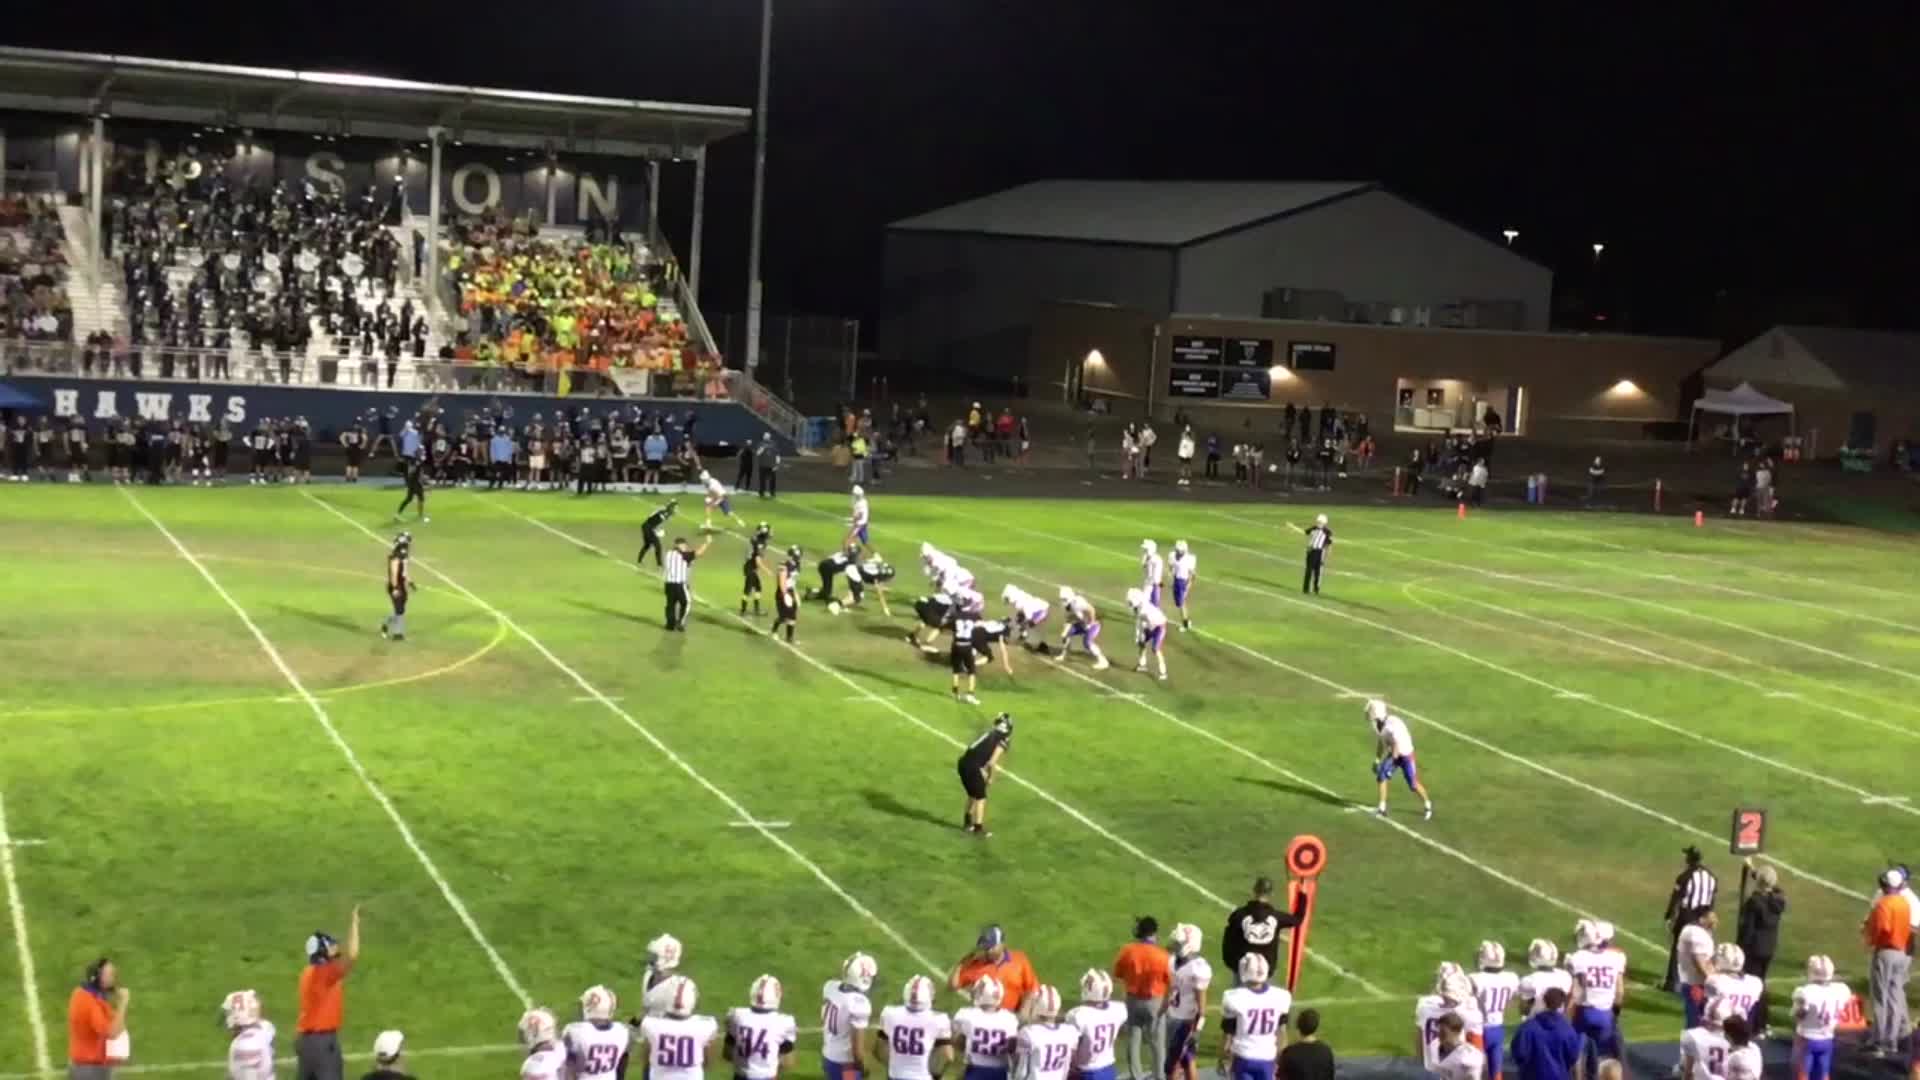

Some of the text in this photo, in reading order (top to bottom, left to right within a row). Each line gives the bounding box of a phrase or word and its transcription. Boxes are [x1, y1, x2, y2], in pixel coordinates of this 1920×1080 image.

[54, 389, 246, 423] HAWKS
[1738, 811, 1761, 848] 2
[1487, 987, 1511, 1012] 10
[1247, 1008, 1275, 1035] 76
[657, 1034, 695, 1068] 50
[893, 1025, 925, 1056] 66
[584, 1045, 619, 1075] 53
[1041, 1043, 1068, 1073] 12
